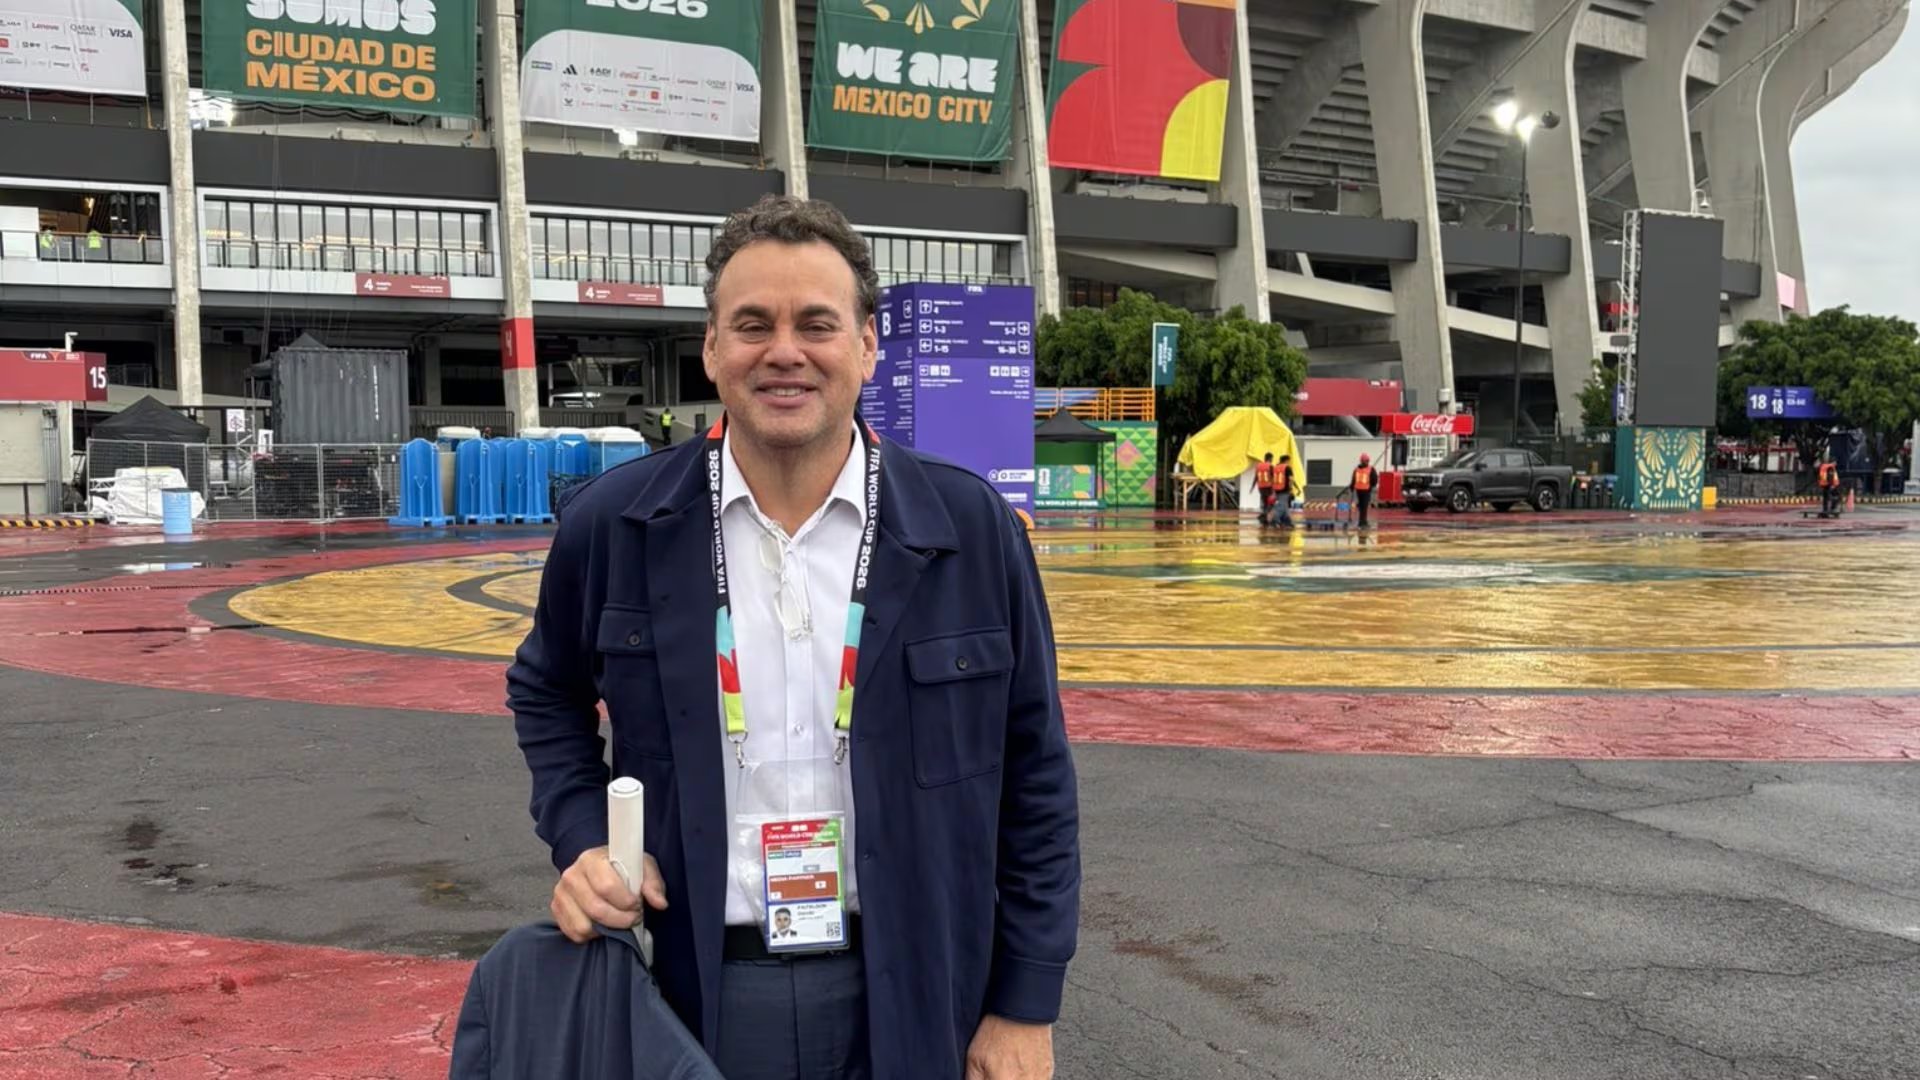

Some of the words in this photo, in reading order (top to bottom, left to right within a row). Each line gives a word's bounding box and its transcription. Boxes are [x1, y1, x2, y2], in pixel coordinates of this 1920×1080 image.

[109, 28, 133, 38] VISA
[245, 28, 385, 66] CIUDAD
[391, 43, 436, 72] DE
[836, 41, 904, 85] WE
[908, 50, 999, 94] ARE
[245, 60, 436, 102] MÉXICO
[735, 82, 755, 92] VISA
[832, 84, 932, 120] MEXICO
[938, 95, 993, 125] CITY
[364, 278, 374, 291] 4
[585, 286, 595, 299] 4
[882, 312, 891, 336] B
[89, 366, 107, 389] 15
[1749, 394, 1767, 410] 18
[1771, 398, 1783, 415] 18
[708, 448, 721, 492] 2026
[869, 447, 881, 472] FIFA
[711, 493, 721, 518] CUP
[868, 473, 879, 518] WORLD
[713, 520, 725, 566] WORLD
[865, 519, 876, 544] CUP
[717, 566, 727, 594] FIFA
[856, 546, 871, 591] 2026
